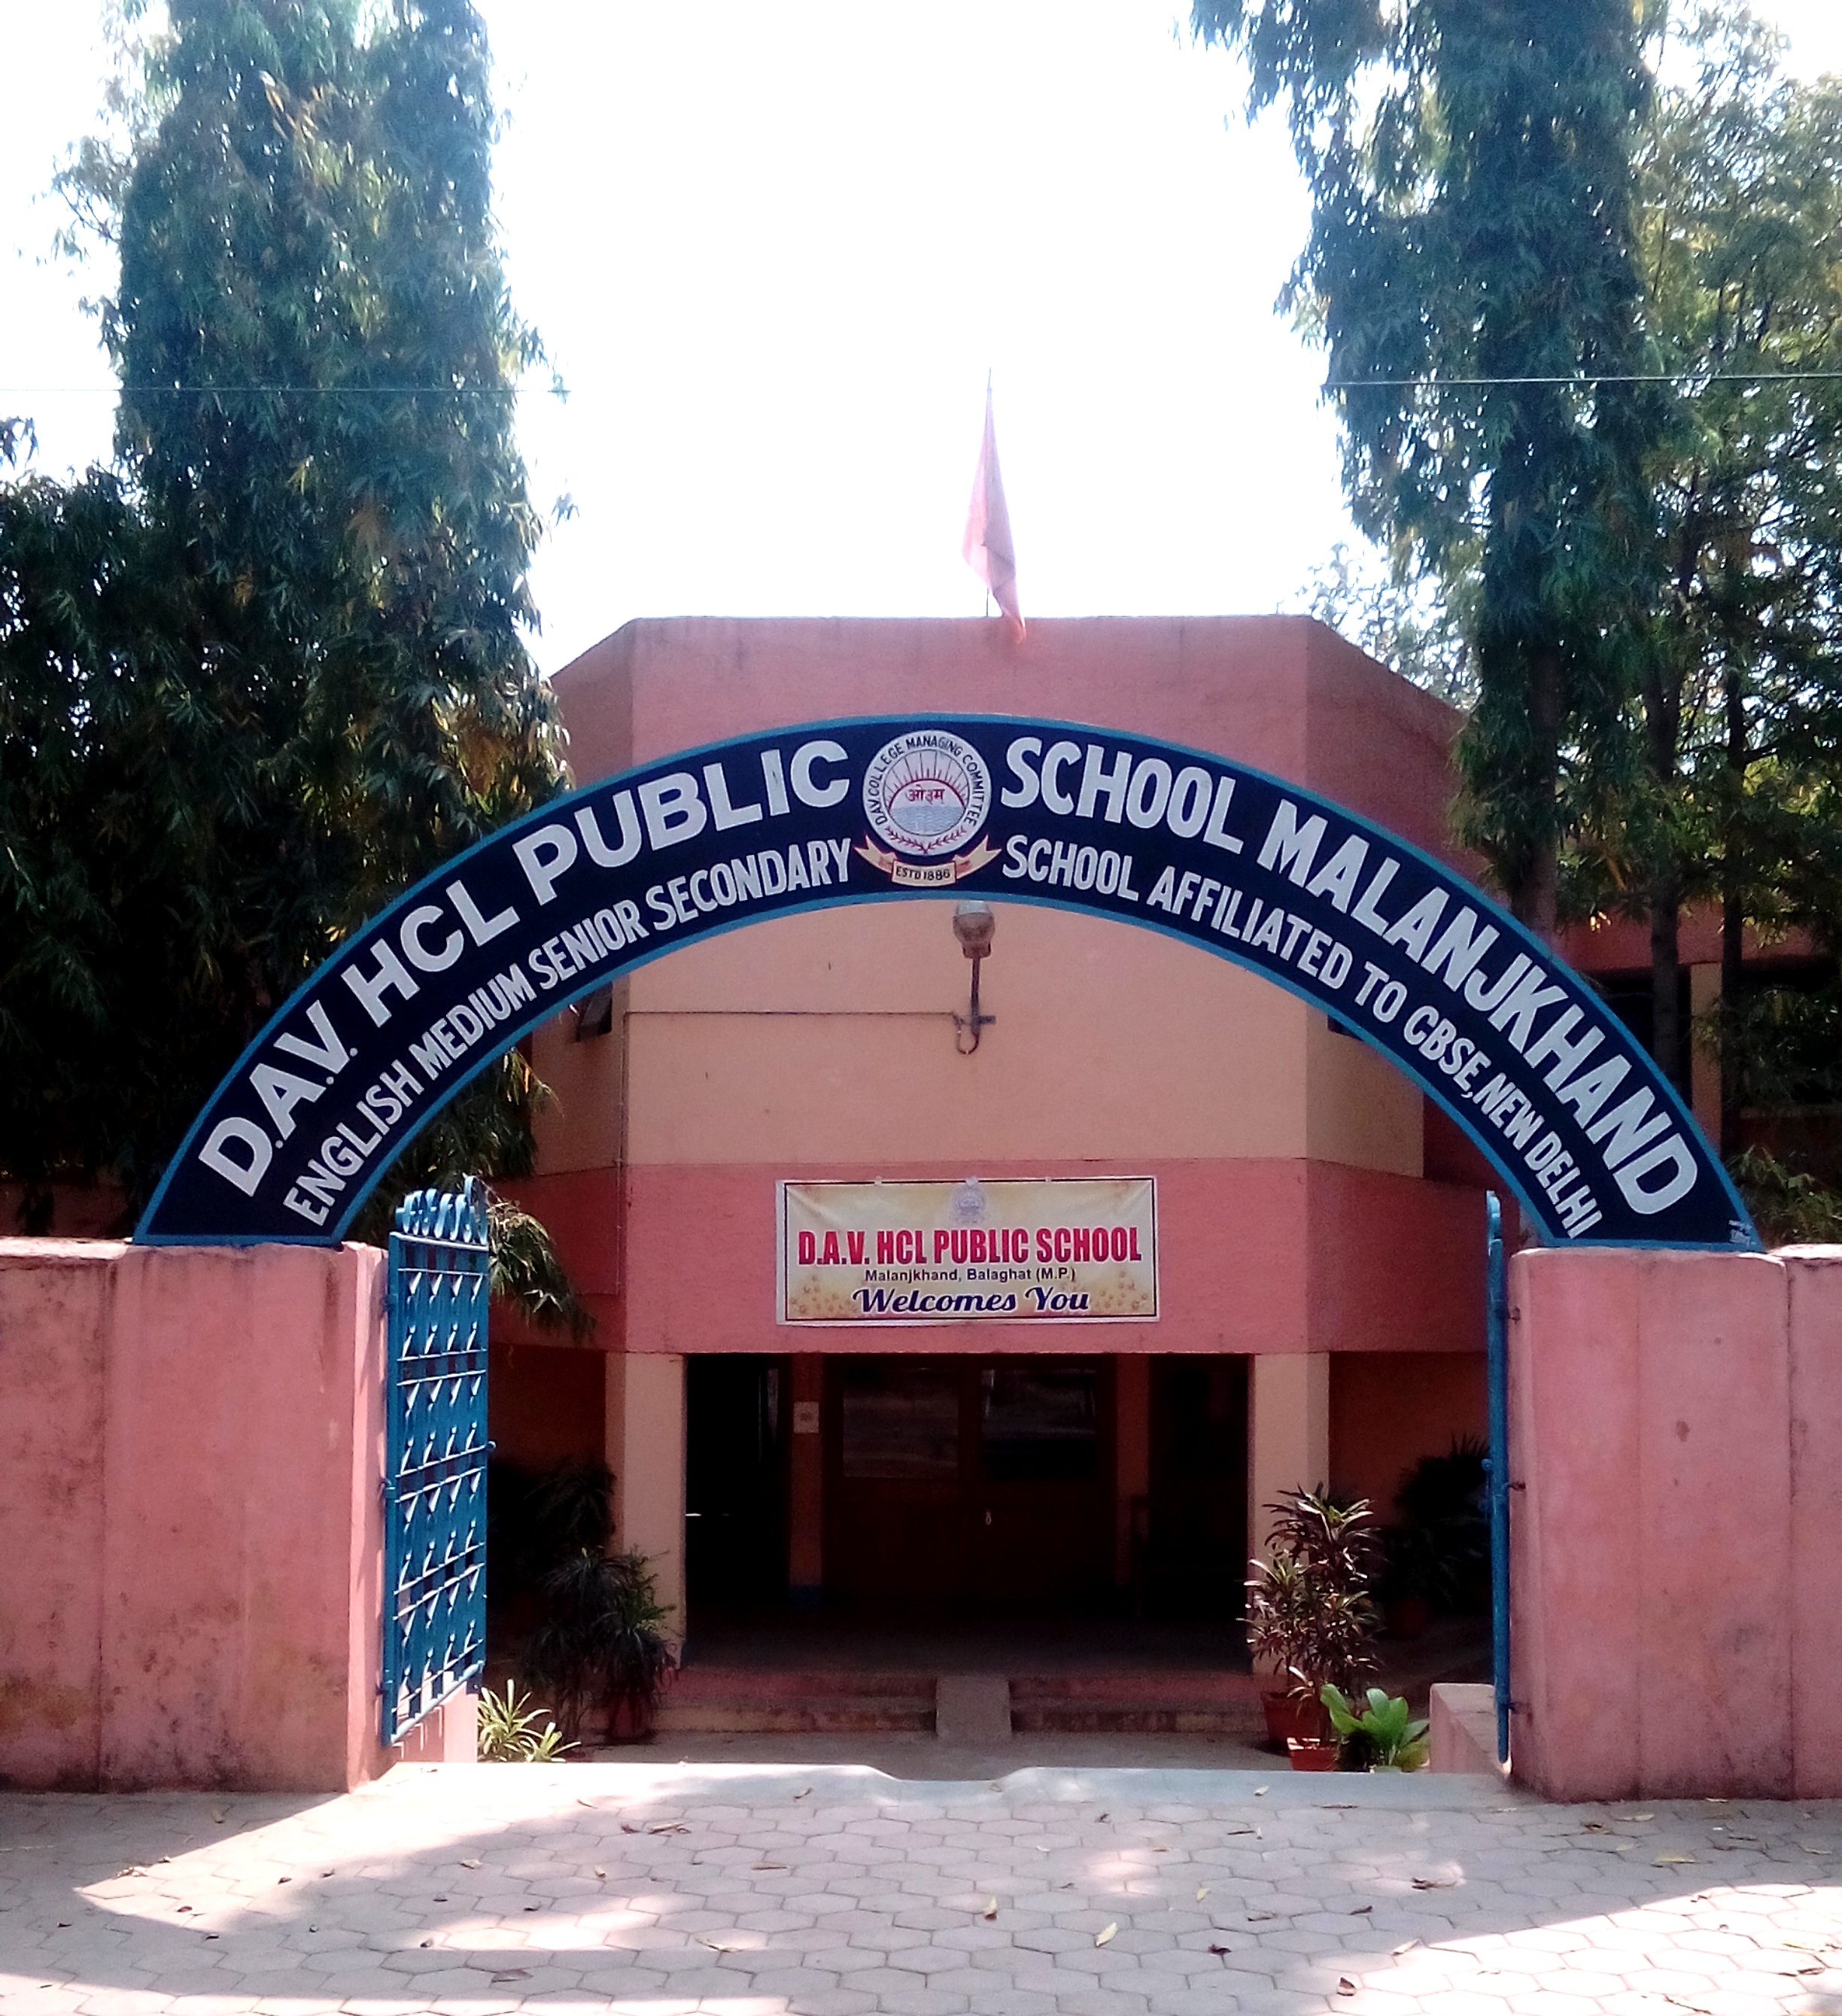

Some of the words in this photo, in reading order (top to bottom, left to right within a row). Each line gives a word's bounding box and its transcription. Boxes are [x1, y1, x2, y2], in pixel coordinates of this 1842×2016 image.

[868, 743, 904, 796] COLLEGE
[905, 735, 963, 756] MANAGING
[962, 754, 985, 827] COMMITTEE
[923, 868, 951, 881] 1886
[198, 999, 358, 1197] D.A.V.
[340, 879, 521, 1028] HCL
[512, 740, 850, 906] PUBLIC
[1000, 737, 1244, 855] SCHOOL
[1256, 798, 1698, 1215] MALANJKHAND
[282, 1059, 424, 1227] ENGLISH
[408, 963, 537, 1081] MEDIUM
[528, 899, 650, 990] SENIOR
[645, 838, 852, 931] SECONDARY
[1002, 835, 1139, 902] SCHOOL
[1146, 865, 1353, 990] AFFILIATED
[1354, 961, 1408, 1023] TO
[1473, 1072, 1544, 1151] NEW
[1524, 1130, 1603, 1239] DELHI
[798, 1230, 871, 1265] D.A.V.
[877, 1230, 928, 1264] HCL
[934, 1228, 1029, 1264] PUBLIC
[1036, 1227, 1142, 1263] SCHOOL
[865, 1269, 962, 1284] Malanjkhand,
[967, 1268, 1032, 1283] Balaghat
[852, 1288, 1017, 1313] Welcomes
[1024, 1286, 1090, 1312] You
